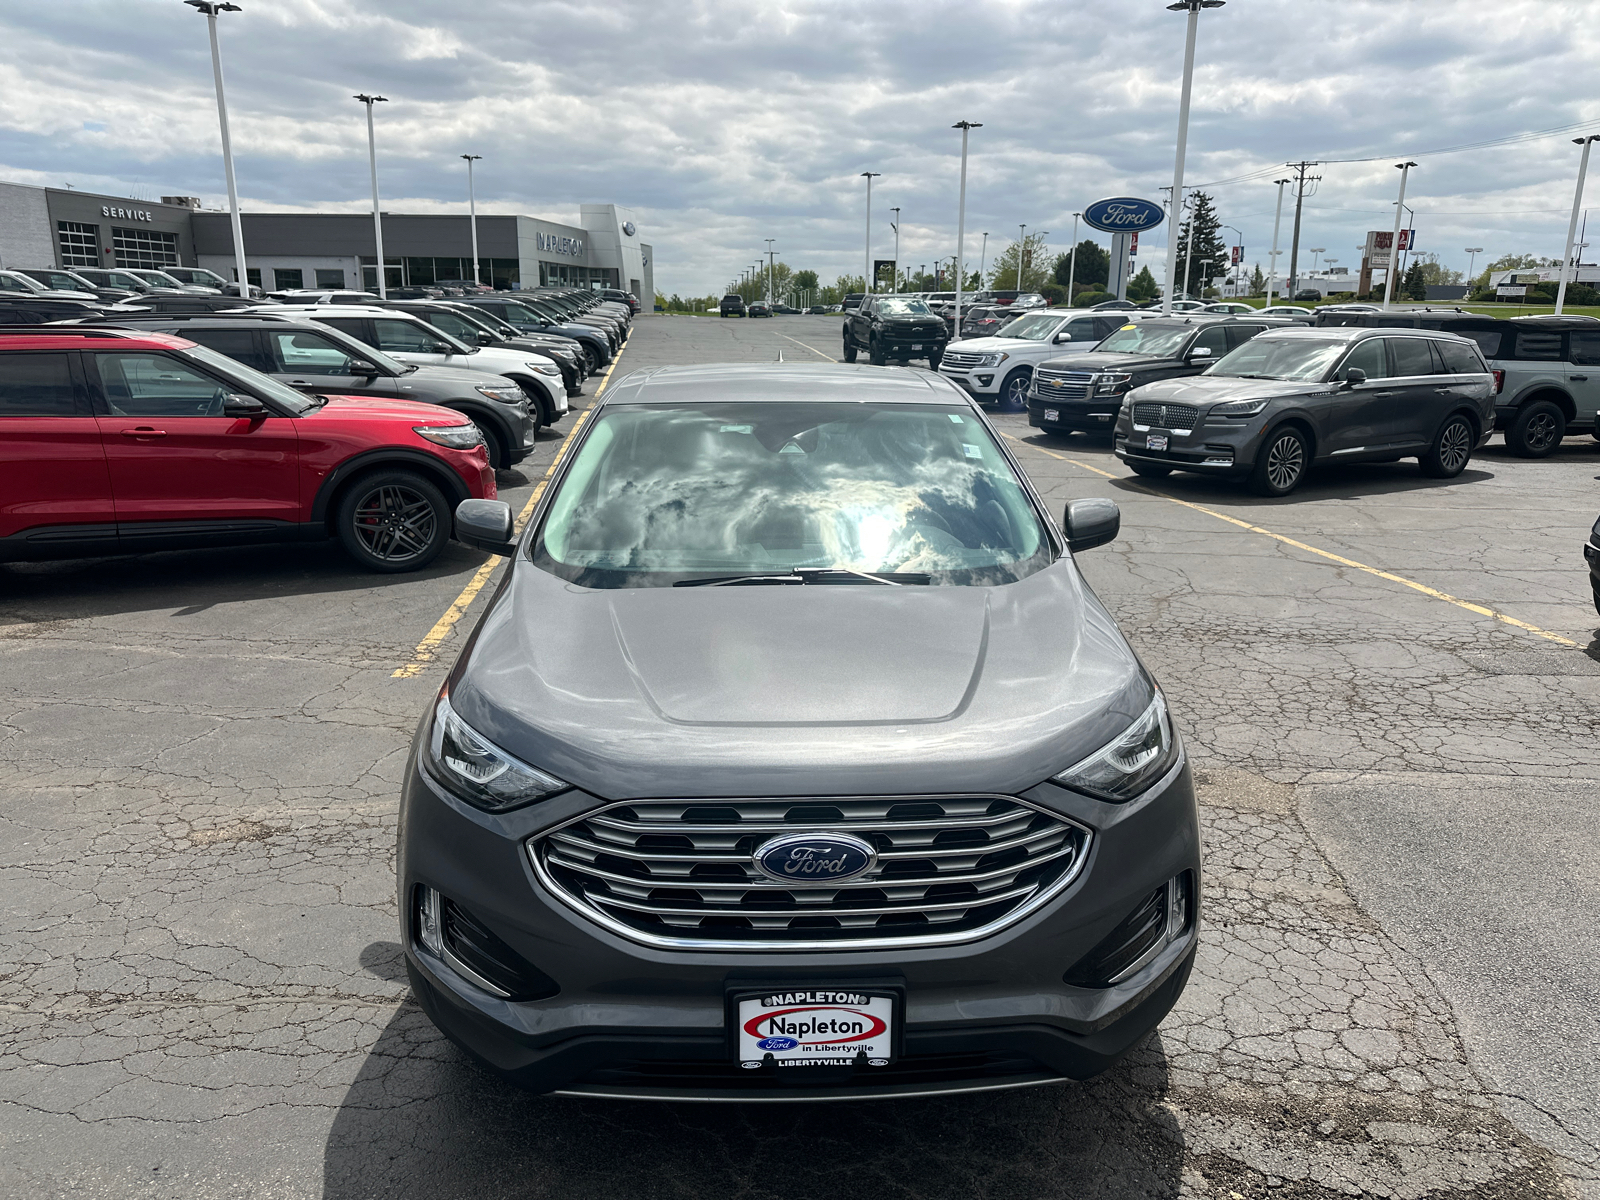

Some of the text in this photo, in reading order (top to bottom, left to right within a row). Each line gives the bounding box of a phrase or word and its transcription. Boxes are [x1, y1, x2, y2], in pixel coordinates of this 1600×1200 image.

[102, 206, 152, 221] SERVICE
[1102, 203, 1149, 225] Ford
[537, 232, 583, 257] NAPLETON
[783, 847, 848, 874] Ford
[772, 992, 860, 1006] NAPLETON
[769, 1017, 863, 1038] Napleton
[765, 1038, 791, 1050] Ford
[815, 1044, 874, 1053] Libertyville
[778, 1059, 853, 1067] LIBERTYVILLE
